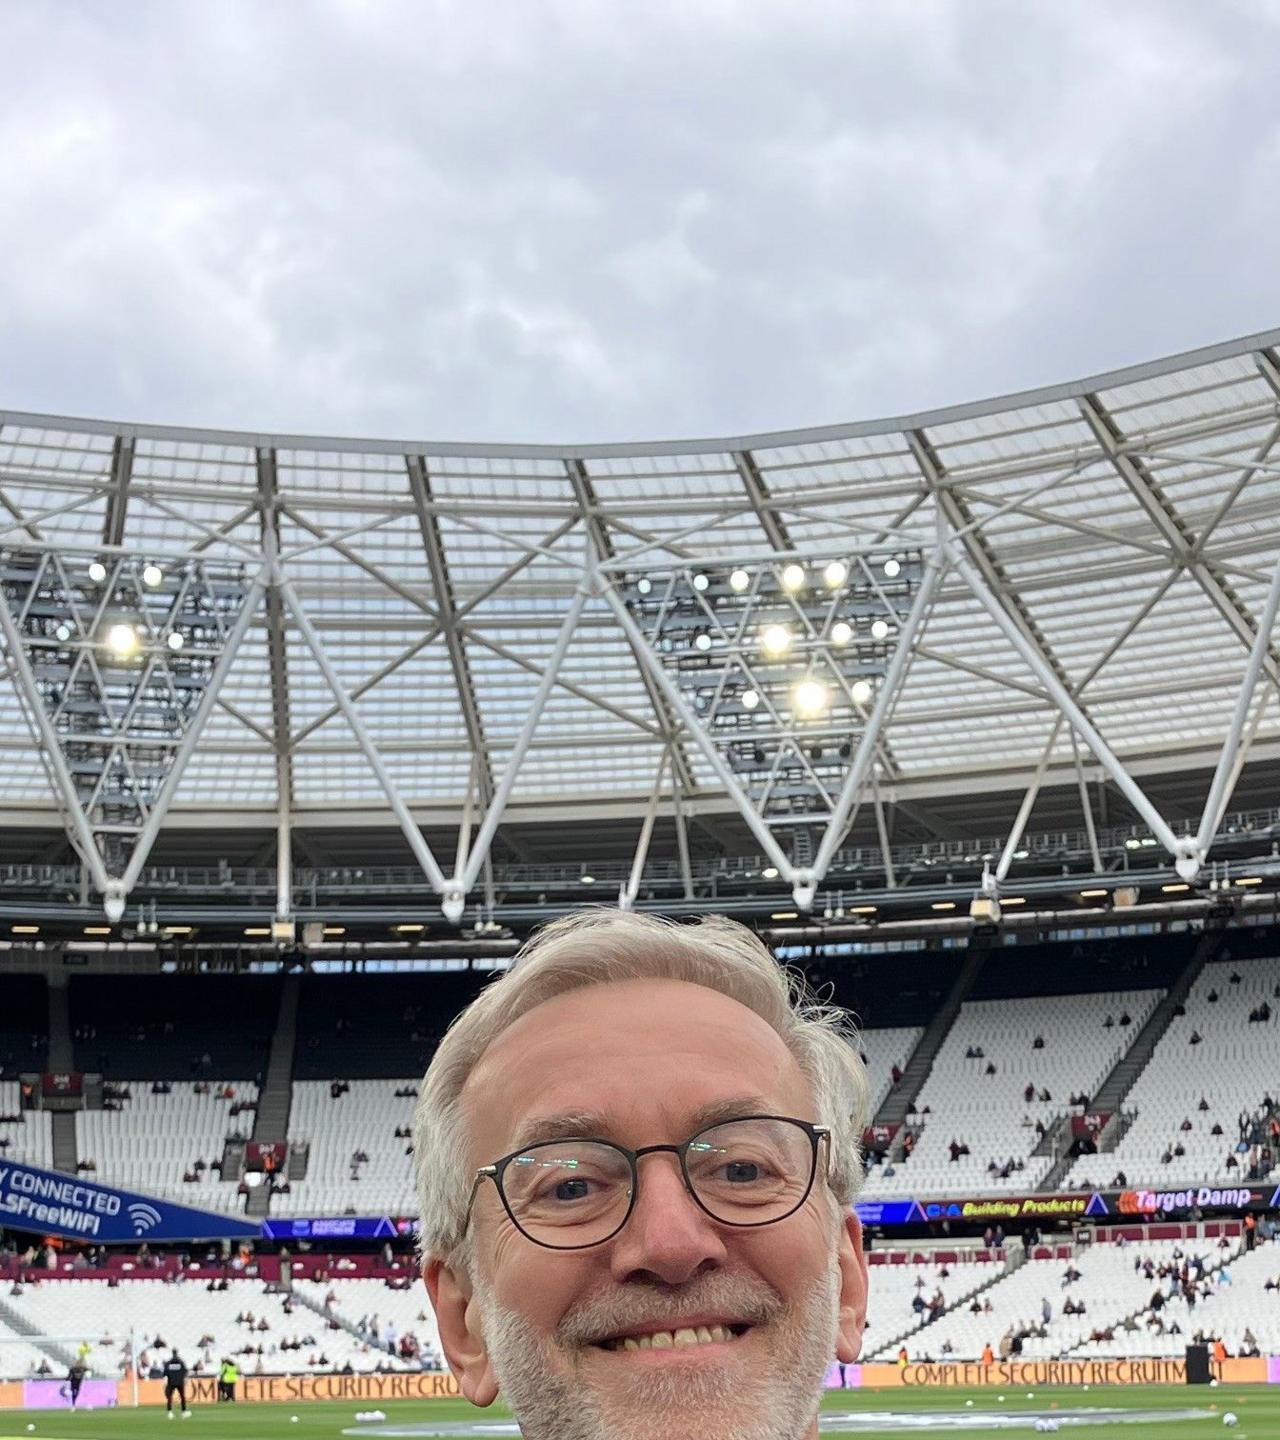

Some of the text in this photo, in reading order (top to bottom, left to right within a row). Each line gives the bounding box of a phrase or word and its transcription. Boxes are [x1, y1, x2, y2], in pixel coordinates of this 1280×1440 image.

[10, 1172, 120, 1216] CONNECTED
[1136, 1187, 1251, 1212] Target Damp
[962, 1202, 1020, 1218] Building
[1022, 1199, 1086, 1214] Products
[901, 1362, 994, 1385] COMPLETE
[998, 1360, 1087, 1384] SECURITY
[285, 1374, 388, 1399] SECURITY
